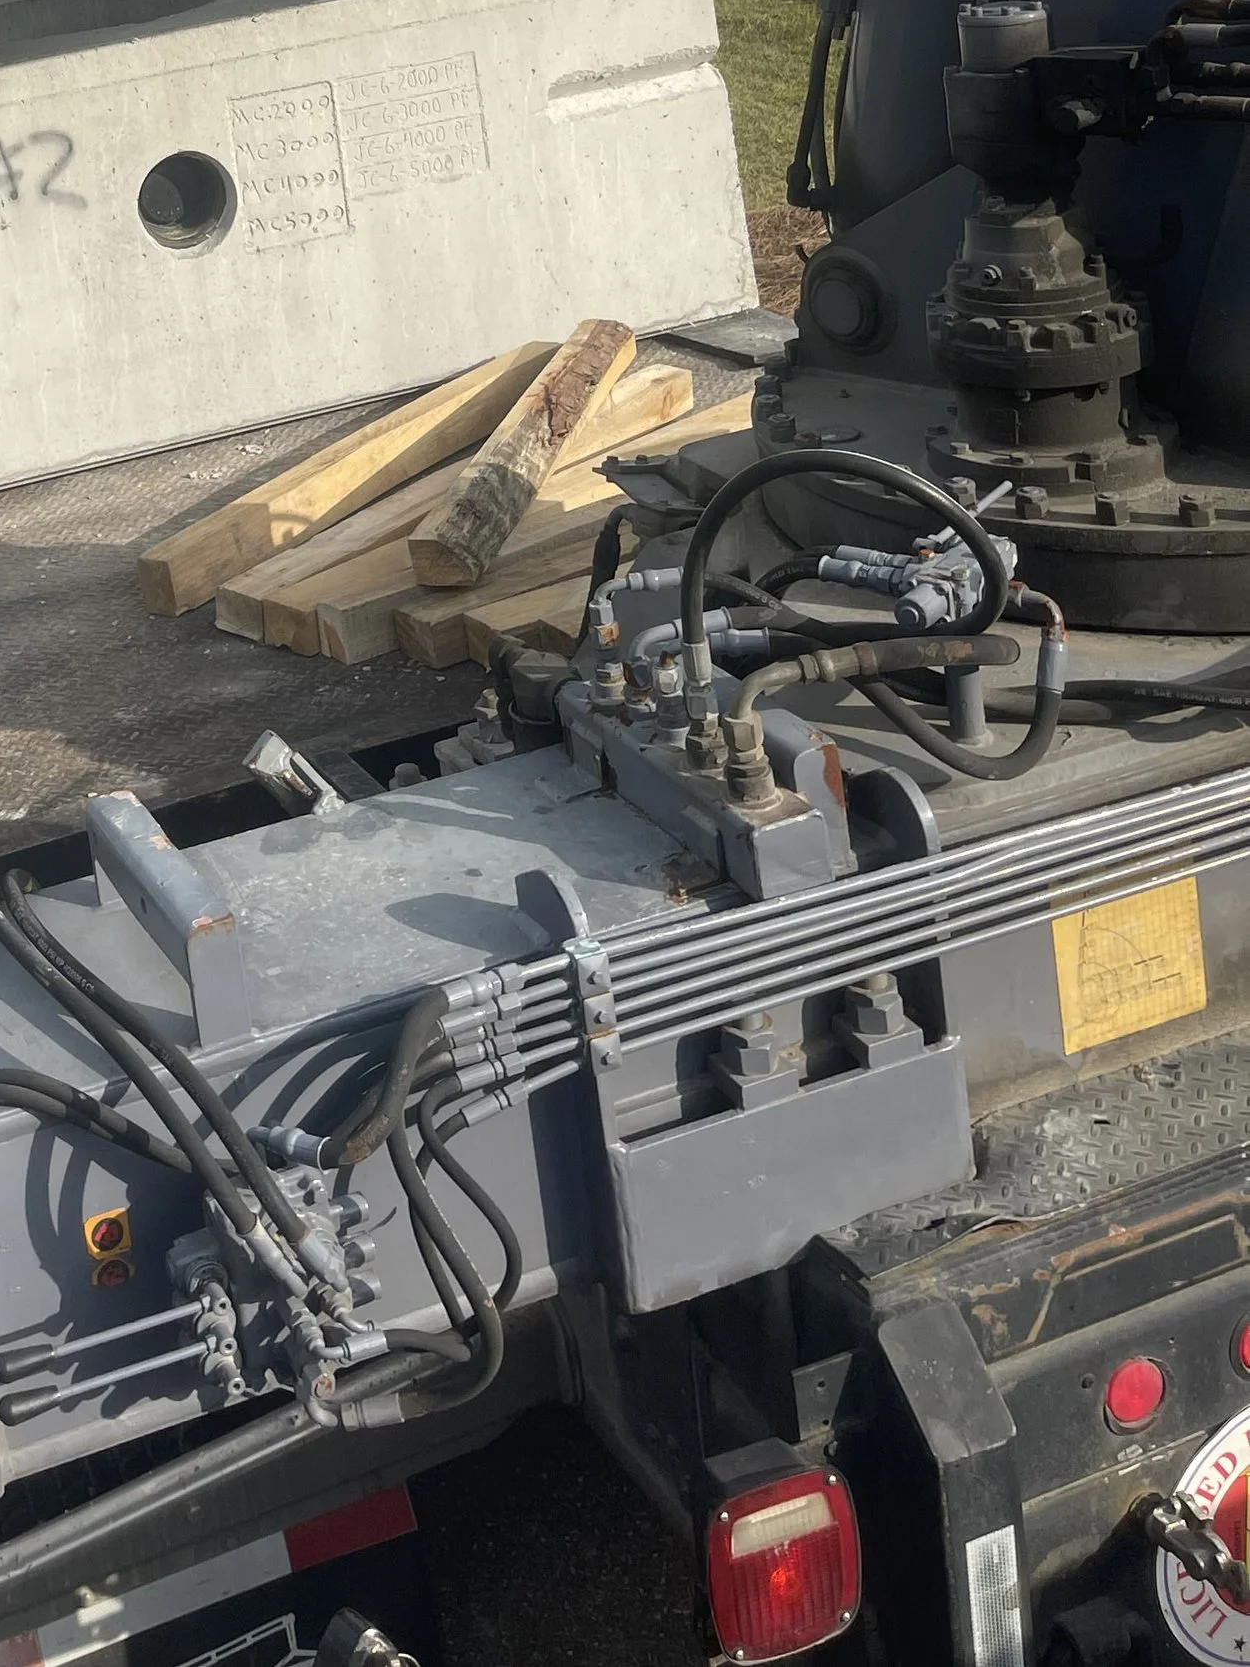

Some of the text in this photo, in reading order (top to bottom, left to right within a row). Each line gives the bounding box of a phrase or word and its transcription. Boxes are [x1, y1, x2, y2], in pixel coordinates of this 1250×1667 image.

[231, 95, 330, 128] MC2000
[236, 132, 334, 163] MC3000
[242, 169, 339, 205] MC4000
[247, 205, 344, 236] MC5000
